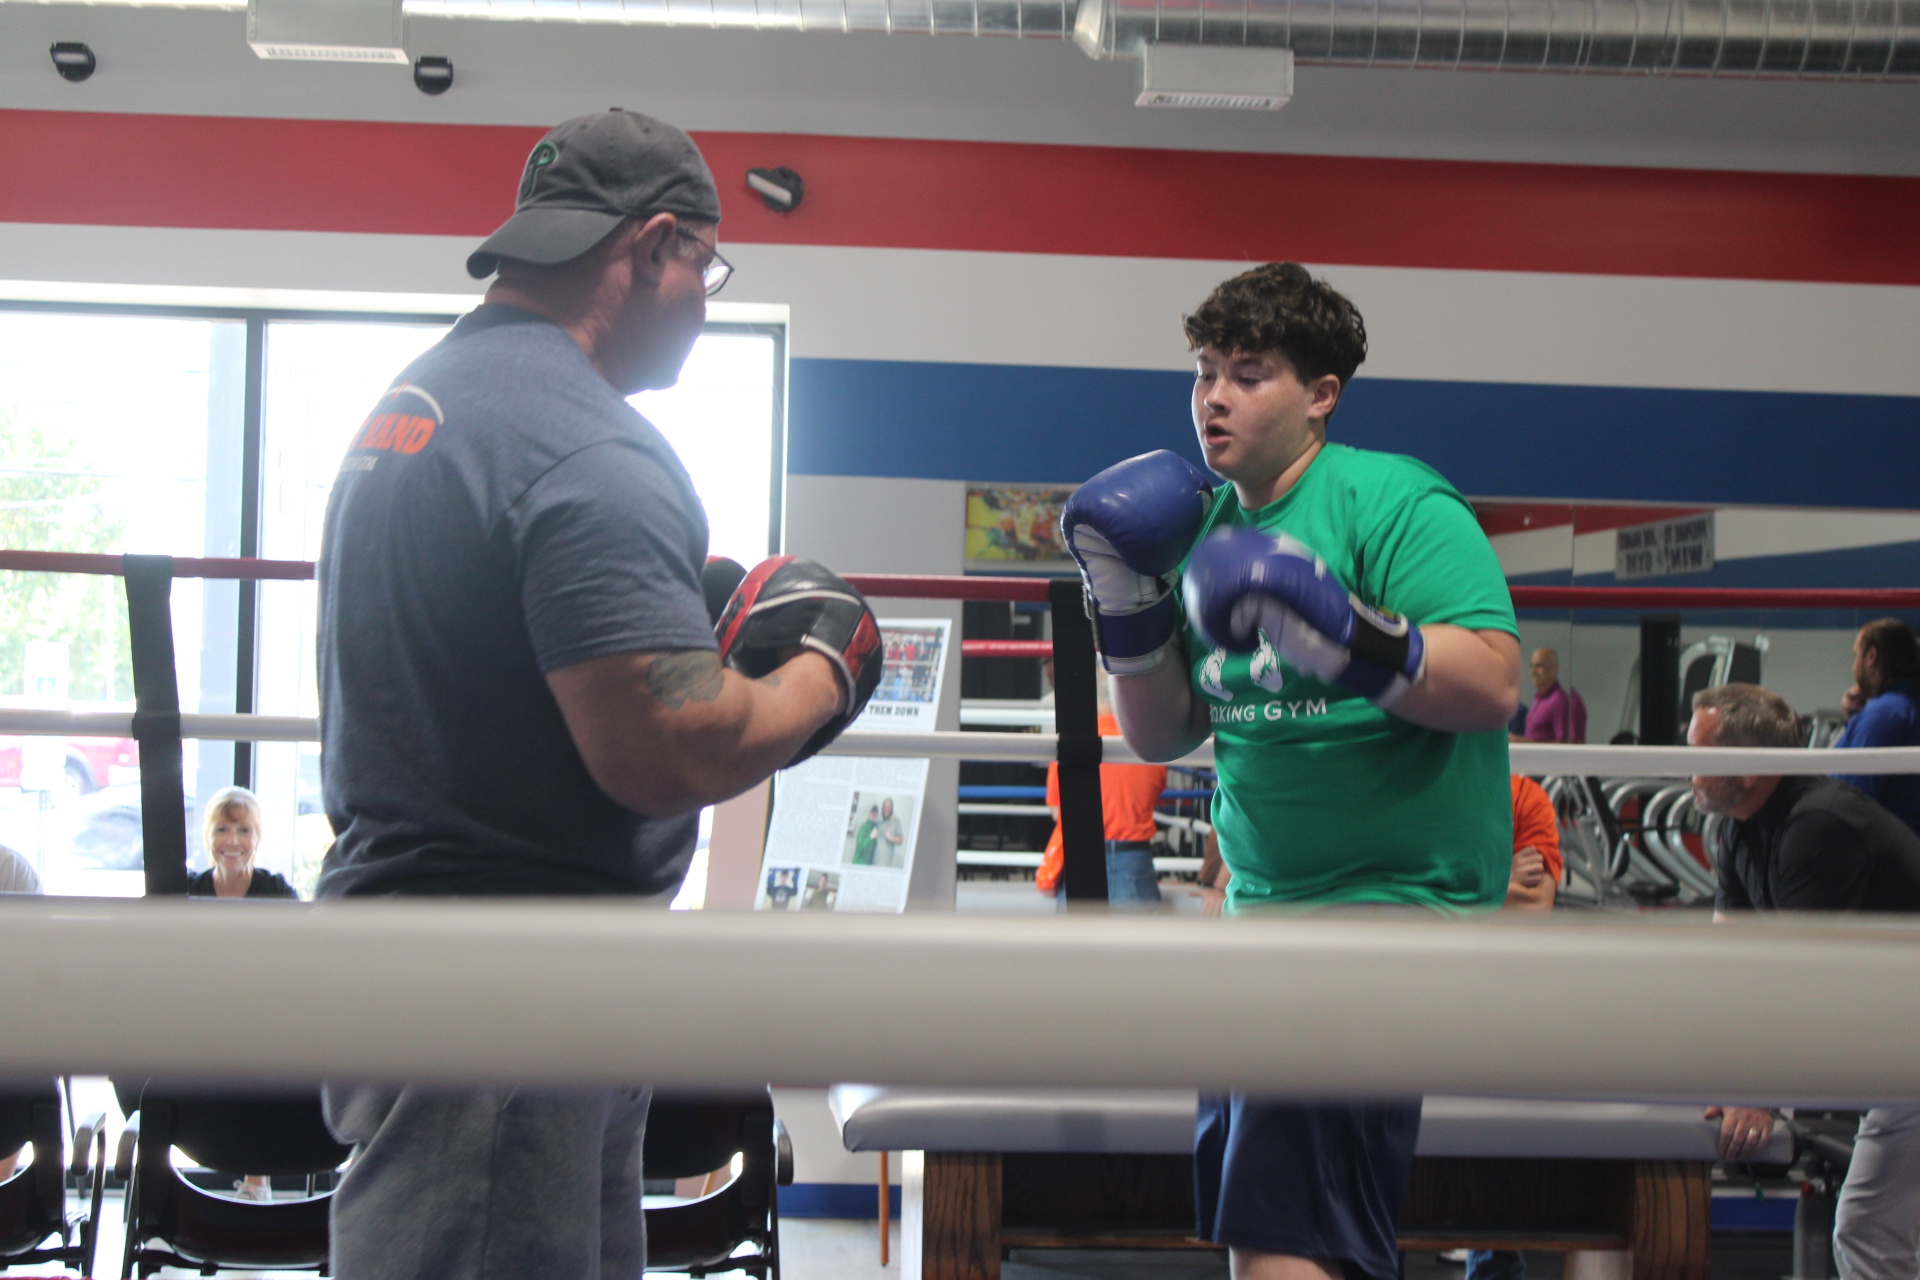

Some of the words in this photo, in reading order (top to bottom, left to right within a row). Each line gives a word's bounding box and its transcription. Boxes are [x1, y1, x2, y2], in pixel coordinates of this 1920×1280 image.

[869, 704, 893, 716] THEM
[894, 706, 920, 717] DOWN
[1264, 698, 1327, 721] GYM
